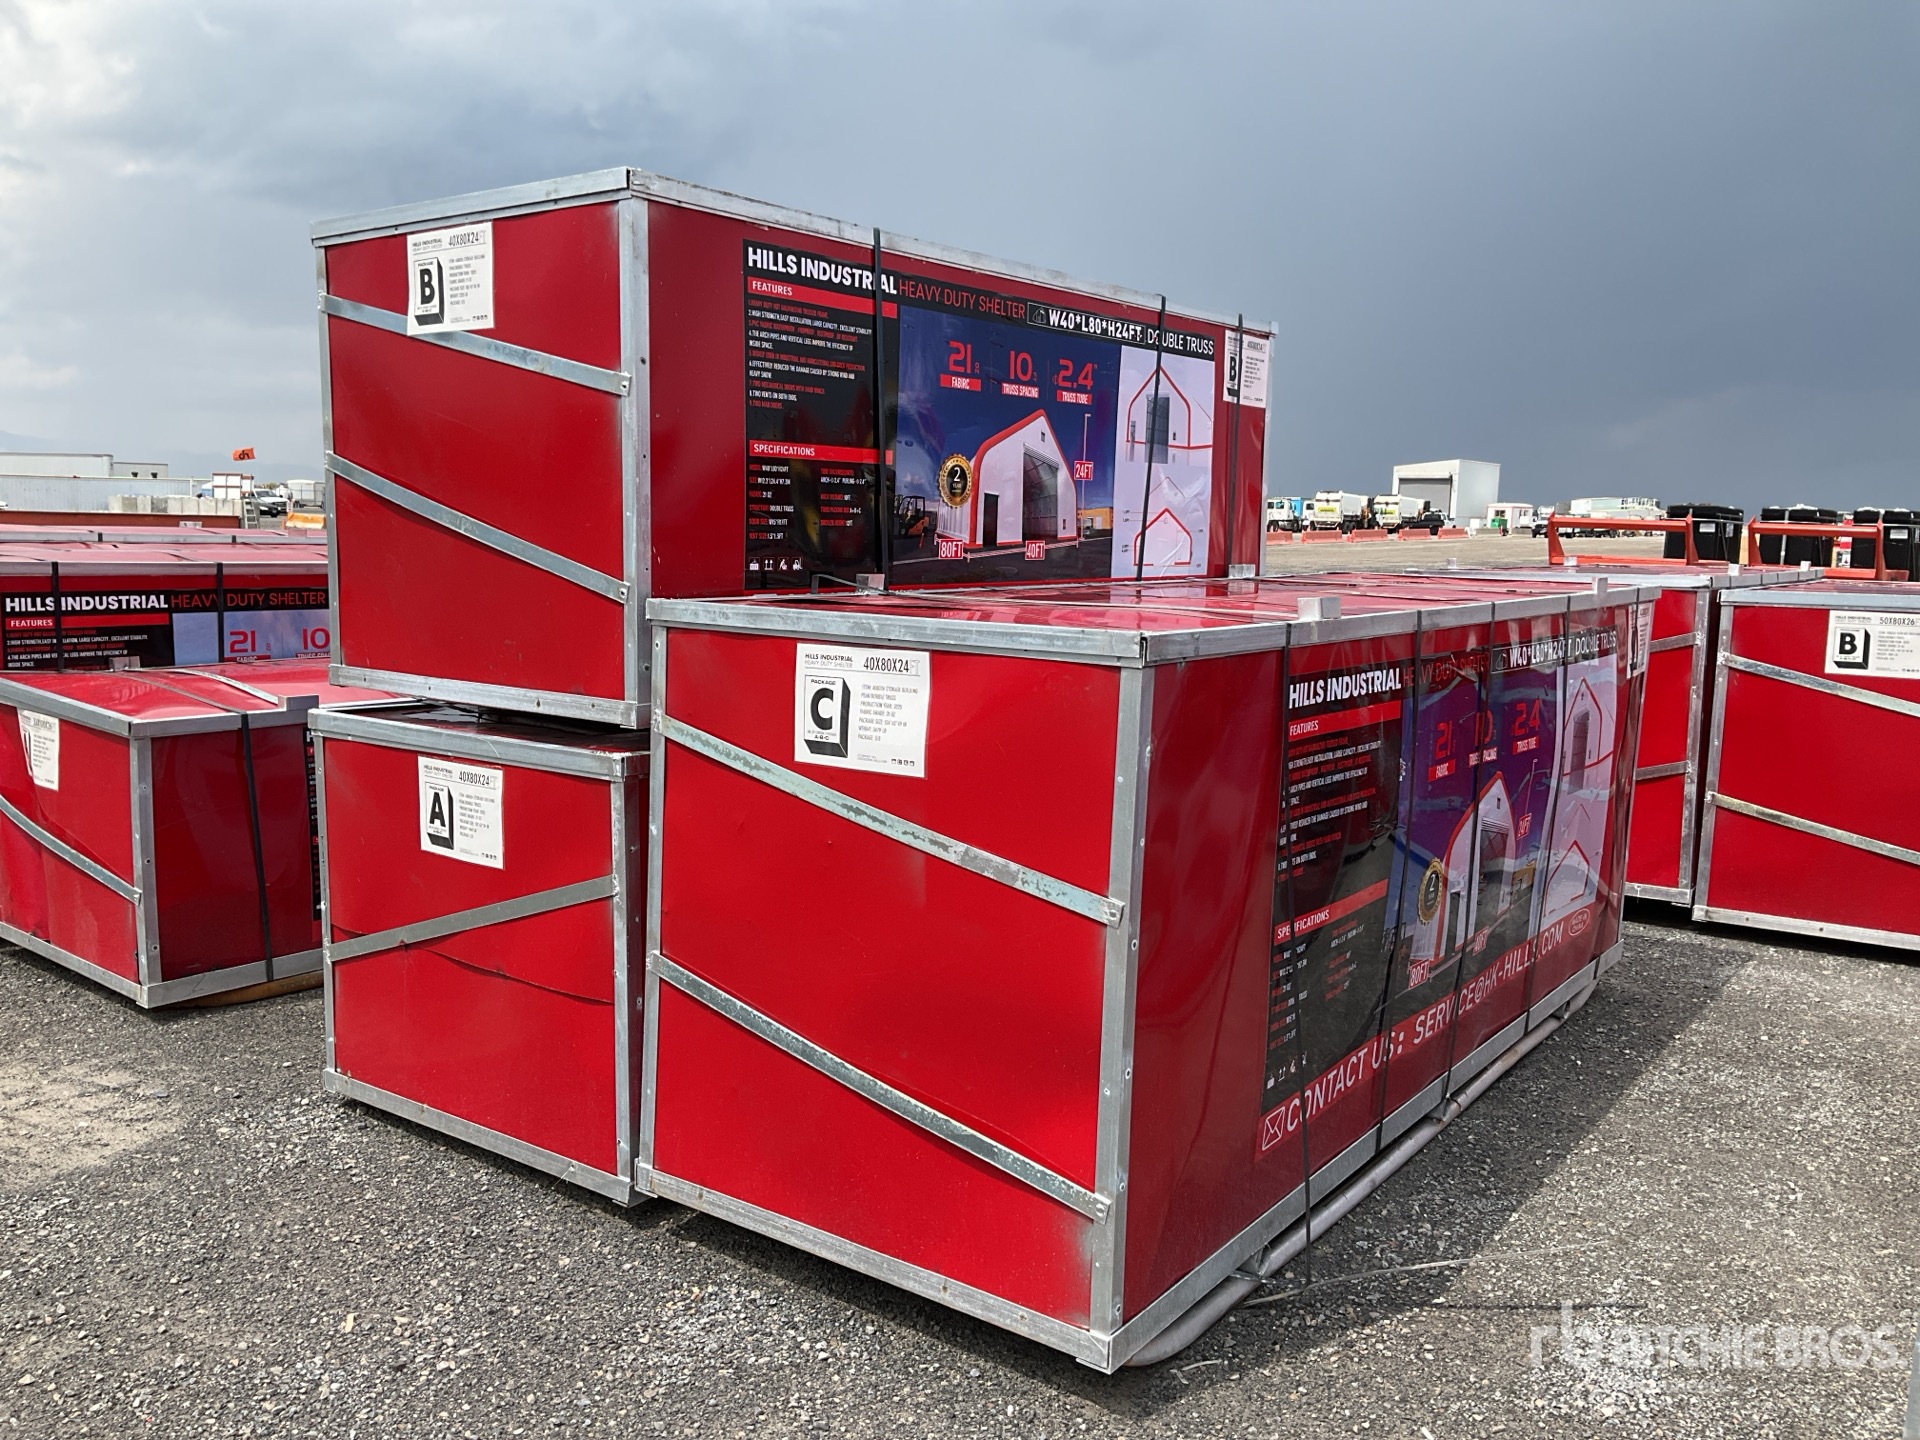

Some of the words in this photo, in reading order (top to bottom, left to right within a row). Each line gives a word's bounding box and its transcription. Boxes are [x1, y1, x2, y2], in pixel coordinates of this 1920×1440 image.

[420, 268, 435, 305] B
[752, 280, 793, 296] FEATURES
[748, 246, 798, 275] HILLS
[800, 257, 897, 294] INDUSTRIAL
[899, 279, 941, 303] HEAVY
[944, 288, 977, 310] DUTY
[979, 294, 1026, 320] SHELTER
[1148, 328, 1184, 350] DOUBLE
[1186, 336, 1214, 355] TRUSS
[948, 340, 972, 374] 21
[1010, 350, 1033, 382] 10
[1229, 356, 1236, 382] B
[1002, 384, 1018, 395] TRUSS
[1020, 386, 1038, 398] SPACING
[1062, 392, 1076, 402] TRUSS
[1076, 393, 1088, 404] TUBE
[754, 444, 815, 456] SPECIFICATIONS
[954, 466, 960, 482] 2
[1075, 462, 1092, 479] 24FT
[940, 540, 962, 558] 80FT
[1026, 542, 1044, 558] 40FT
[5, 596, 55, 612] HILLS
[61, 594, 168, 610] INDUSTRIAL
[227, 592, 264, 606] DUTY
[269, 592, 326, 606] SHELTER
[10, 619, 53, 628] FEATURES
[230, 630, 256, 653] 21
[302, 628, 330, 650] 10
[1838, 632, 1858, 654] B
[820, 654, 853, 662] INDUSTRIAL
[1288, 679, 1324, 709] HILLS
[1326, 668, 1402, 702] INDUSTRIAL
[810, 688, 834, 730] C
[1290, 720, 1319, 736] FEATURES
[1434, 721, 1452, 759] 21
[429, 792, 446, 828] A
[1430, 873, 1436, 892] 2
[1278, 910, 1330, 938] SPEIFICATIONS
[1410, 962, 1428, 986] 80FT
[1286, 1048, 1368, 1132] CONTACT
